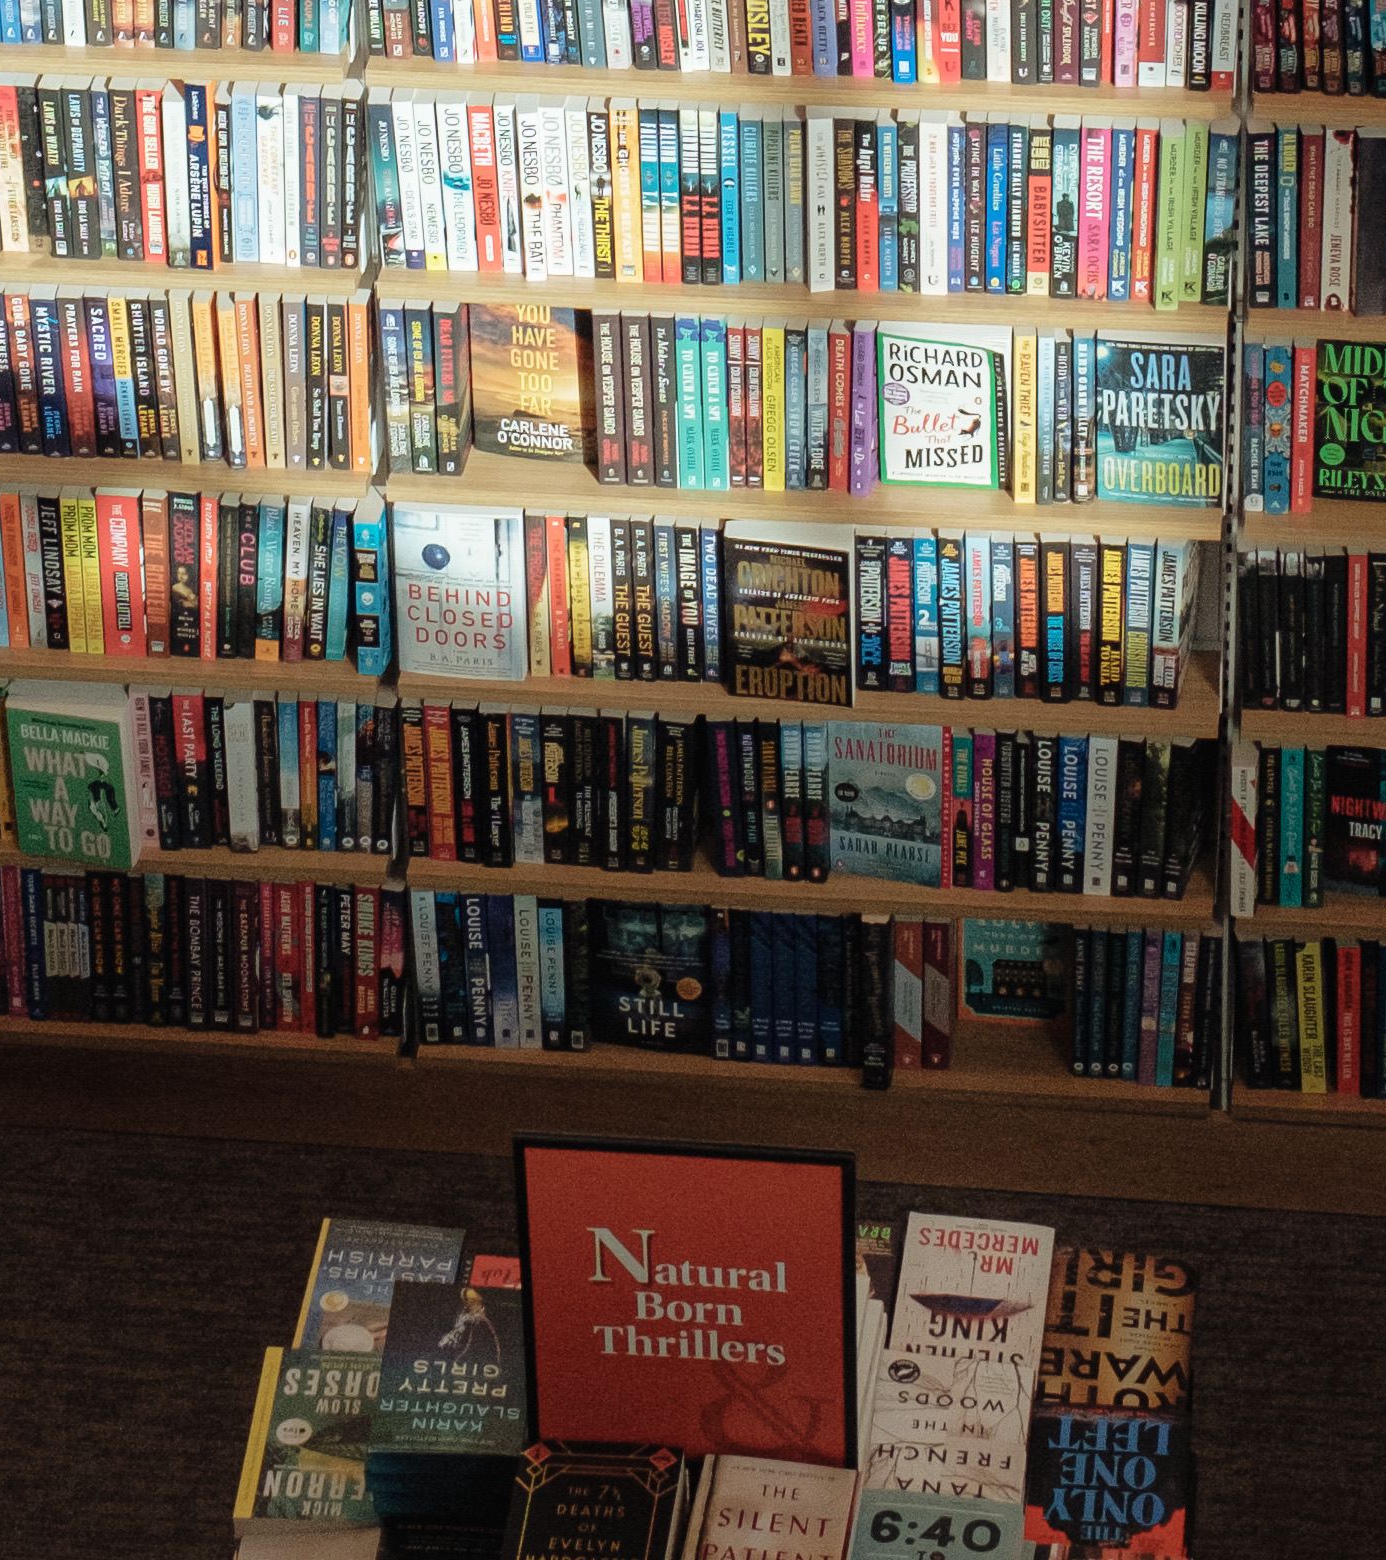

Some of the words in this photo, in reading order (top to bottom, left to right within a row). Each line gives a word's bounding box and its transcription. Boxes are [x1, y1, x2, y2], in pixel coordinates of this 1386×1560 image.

[1085, 135, 1105, 164] THE
[1084, 165, 1104, 221] RESORT
[34, 306, 52, 354] MYSTIC
[515, 303, 551, 325] YOU
[129, 302, 146, 360] SHUTTER
[512, 325, 557, 348] HAVE
[509, 348, 559, 371] GONE
[889, 363, 982, 388] OSMAN
[1130, 351, 1192, 391] SARA
[40, 358, 56, 396] RIVER
[135, 359, 151, 397] ISLAND
[517, 372, 552, 393] TOO
[1322, 375, 1369, 406] OF
[518, 396, 553, 416] FAR
[1102, 388, 1221, 431] PARETSKY
[500, 417, 570, 438] CARLENE
[892, 413, 959, 435] Bullet
[497, 430, 574, 451] O'CONNOR
[904, 444, 984, 469] MISSED
[1103, 455, 1221, 497] OVERBOARD
[1318, 467, 1368, 491] RILEY
[408, 583, 511, 608] BEHIND
[407, 604, 513, 629] CLOSED
[415, 626, 506, 650] DOORS
[735, 663, 848, 705] ERUPTION
[23, 745, 87, 780] WHAT
[834, 736, 938, 772] SANATORIUM
[1035, 740, 1052, 794] LOUISE
[54, 774, 70, 801] A
[28, 797, 79, 829] WAY
[43, 824, 75, 853] TO
[80, 829, 112, 859] GO
[1035, 821, 1052, 871] PENNY
[618, 995, 685, 1018] STILL
[627, 1016, 677, 1038] LIFE
[918, 1226, 1041, 1256] MERCEDES
[586, 1226, 788, 1294] Natural
[634, 1290, 744, 1326] Born
[593, 1324, 787, 1367] Thrillers
[929, 1317, 1010, 1343] KING
[1046, 1416, 1171, 1451] LEFT
[1061, 1453, 1156, 1489] ONE
[756, 1484, 800, 1502] THE
[1044, 1484, 1165, 1526] ONLY
[715, 1505, 833, 1539] SILENT
[868, 1507, 1004, 1553] 6:40
